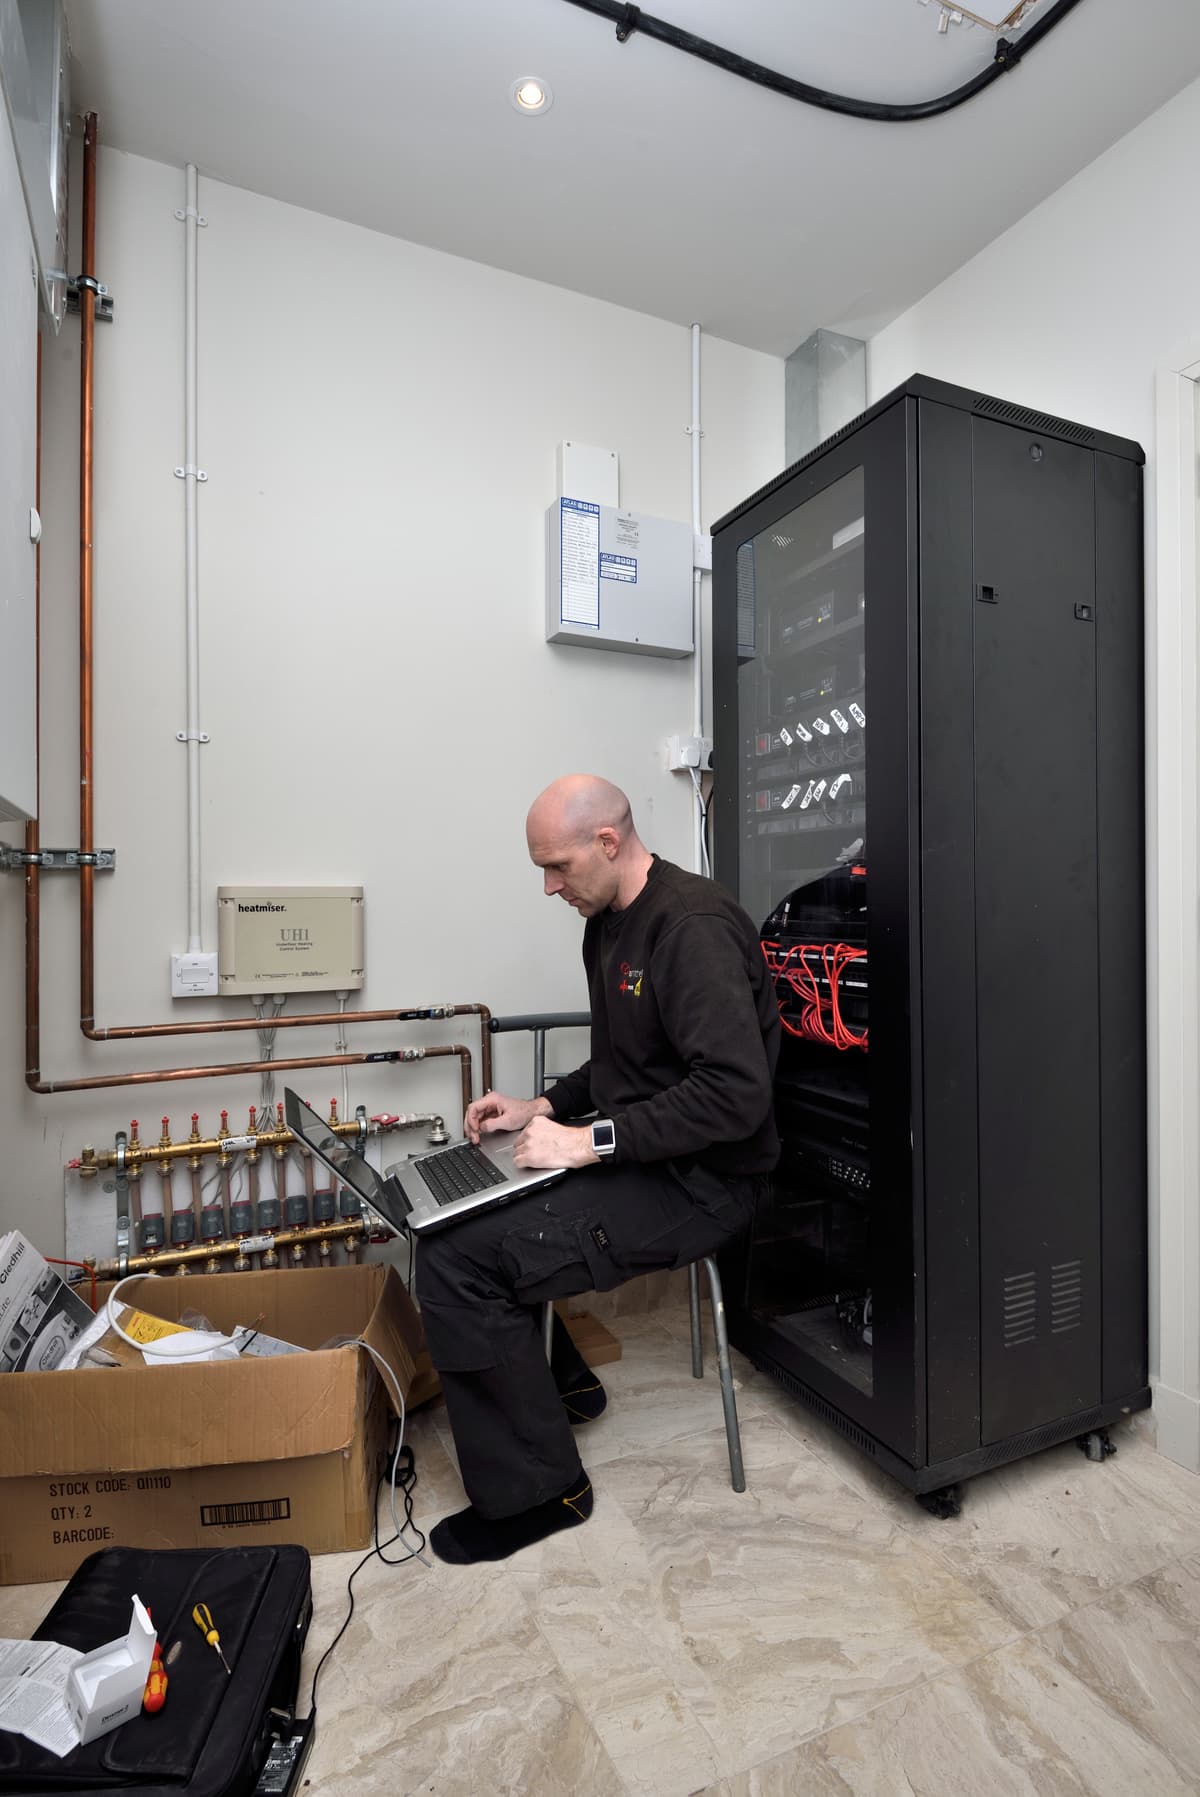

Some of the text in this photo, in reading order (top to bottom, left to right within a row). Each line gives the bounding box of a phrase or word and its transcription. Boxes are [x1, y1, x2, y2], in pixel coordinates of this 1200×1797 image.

[0, 1242, 25, 1285] Gledhill
[49, 1482, 90, 1497] STOCK
[96, 1478, 131, 1493] CODE:
[51, 1505, 92, 1520] QTY: 2
[53, 1526, 115, 1544] BARCODE:
